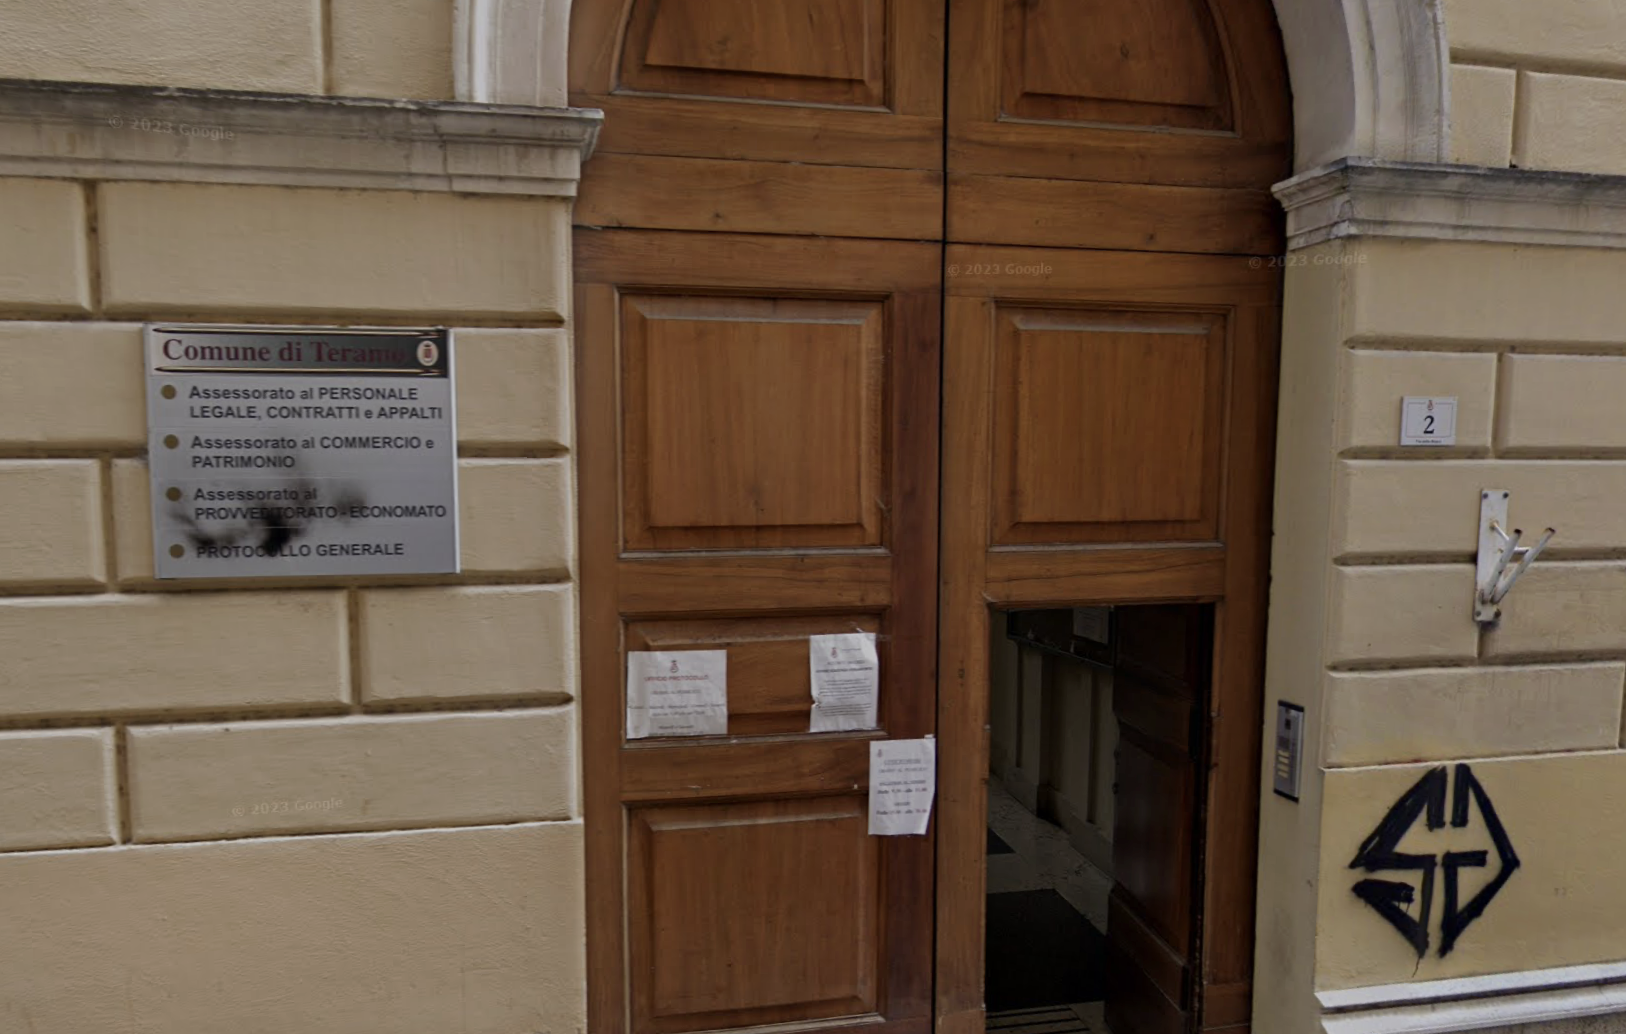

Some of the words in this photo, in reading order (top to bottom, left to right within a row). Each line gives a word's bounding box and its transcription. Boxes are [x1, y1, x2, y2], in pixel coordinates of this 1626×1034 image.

[162, 338, 271, 363] Comune
[278, 339, 302, 362] di
[310, 341, 407, 365] Teramo
[189, 386, 296, 400] Assessorato
[300, 387, 313, 400] al
[318, 387, 418, 401] PERSONALE
[189, 406, 262, 421] LEGALE,
[266, 406, 360, 419] CONTRATTI
[364, 409, 373, 419] e
[376, 407, 442, 420] APPALTI
[1423, 414, 1435, 435] 2
[191, 436, 297, 450] Assessorato
[302, 437, 316, 450] al
[320, 436, 421, 450] COMMERCIO
[426, 440, 434, 450] e
[192, 455, 295, 469] PATRIMONIO
[194, 488, 299, 501] Assessorato
[304, 488, 317, 500] al
[351, 505, 446, 518] ECONOMATO
[316, 543, 404, 557] GENERALE
